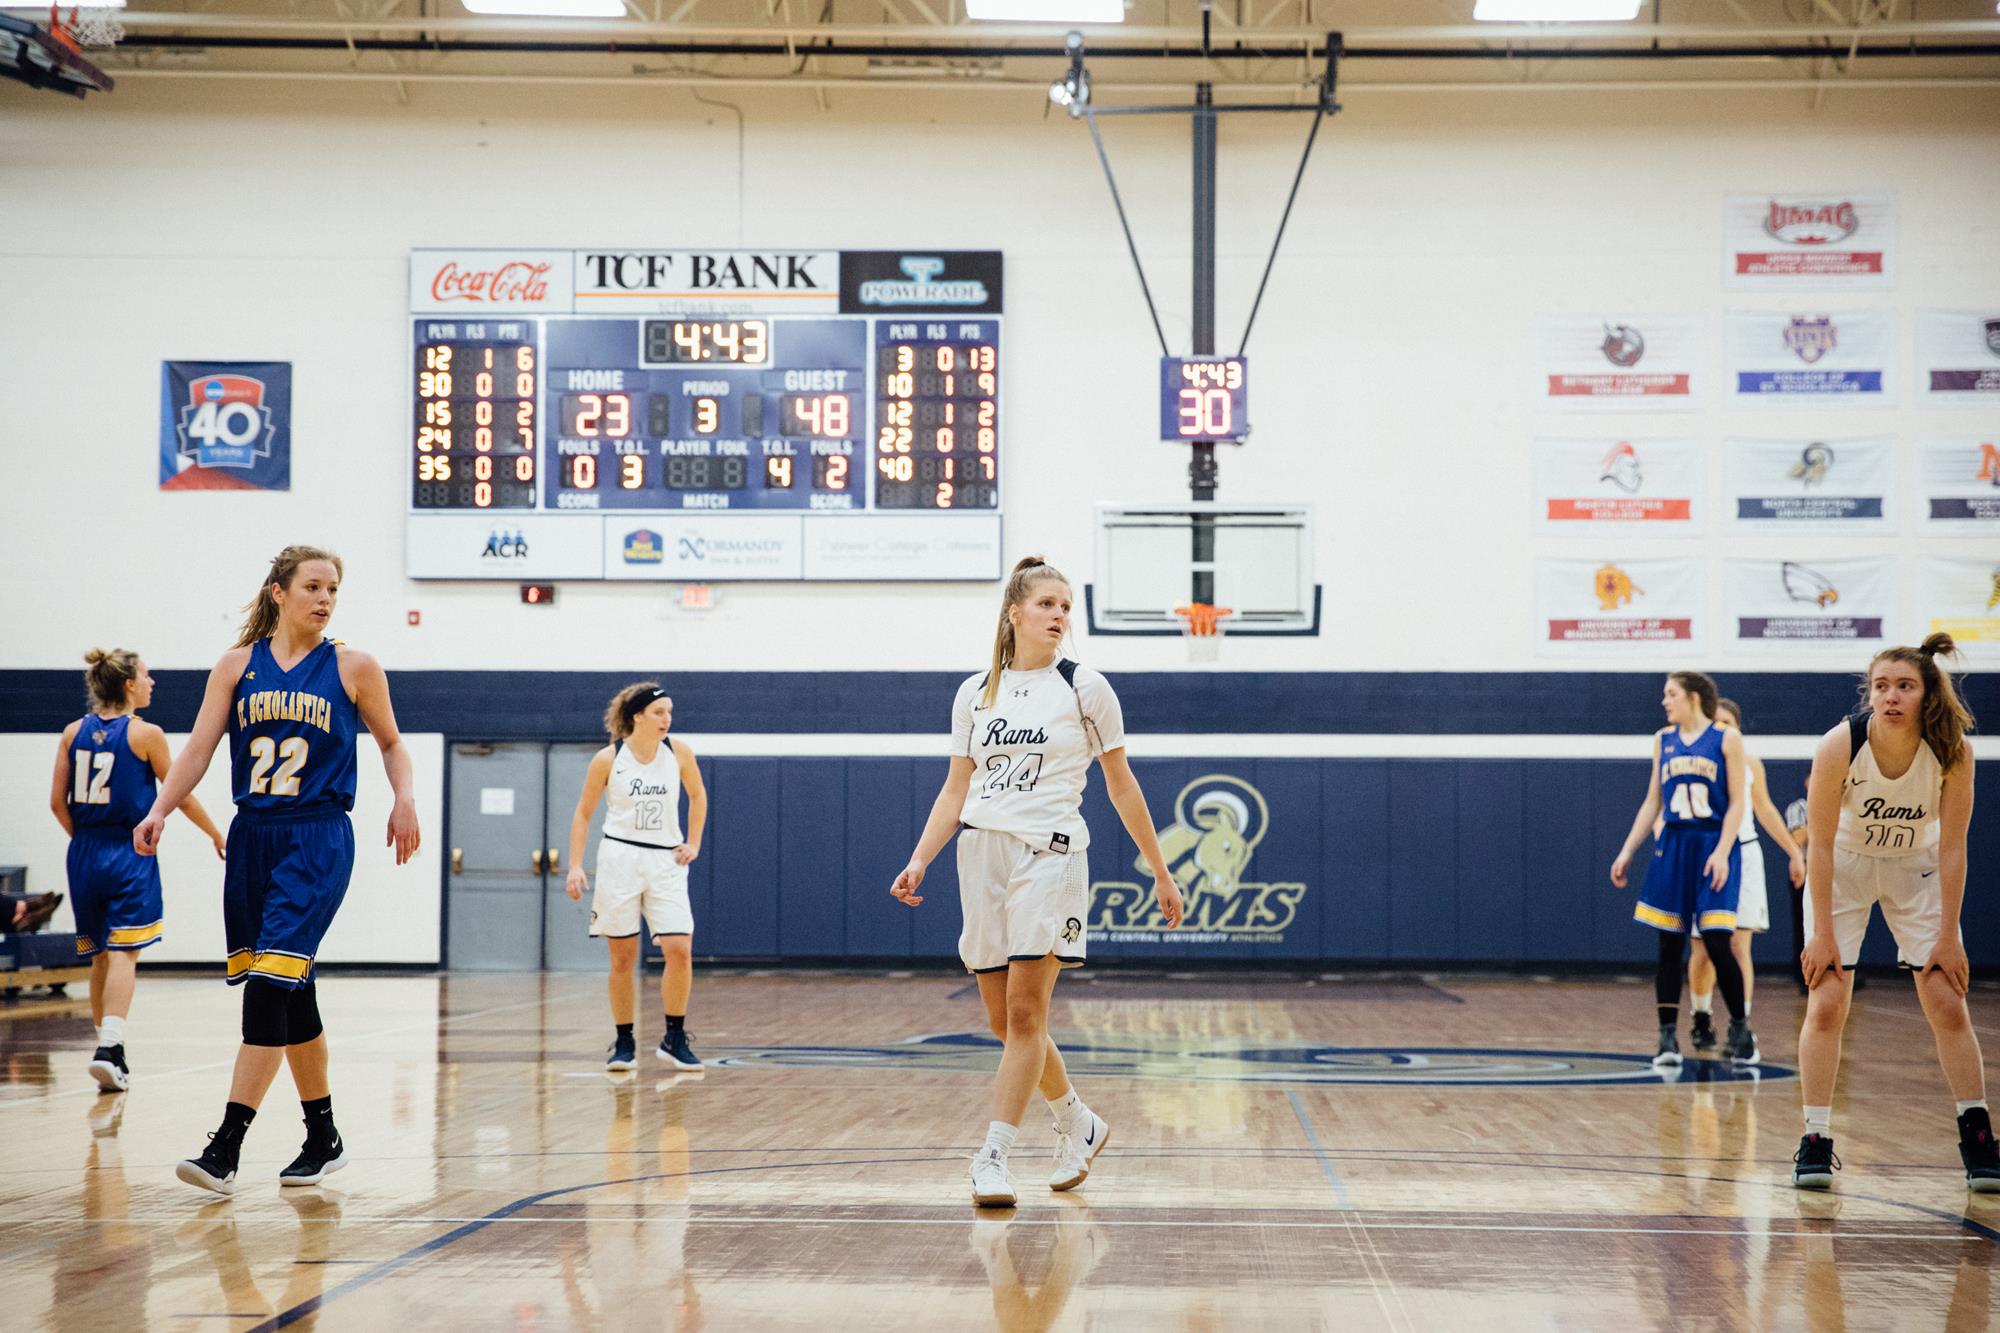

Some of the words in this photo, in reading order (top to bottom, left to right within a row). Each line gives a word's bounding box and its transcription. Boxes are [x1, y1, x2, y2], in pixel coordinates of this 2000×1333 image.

[1769, 200, 1853, 232] UMAC
[586, 255, 672, 288] TCF
[691, 255, 818, 288] BANK
[862, 282, 986, 302] POWERADE
[675, 320, 766, 363] 4:43
[426, 346, 452, 371] 12
[484, 348, 493, 369] 1
[517, 346, 534, 371] 6
[898, 346, 913, 371] 3
[937, 346, 954, 371] 0
[970, 346, 995, 371] 13
[419, 372, 452, 397] 30
[476, 373, 493, 397] 0
[517, 373, 534, 397] 0
[568, 370, 624, 391] HOME
[784, 370, 848, 391] GUEST
[887, 372, 913, 397] 10
[945, 374, 954, 396] 1
[978, 373, 995, 396] 9
[1182, 361, 1242, 389] 4:43
[682, 381, 730, 396] PERIOD
[188, 401, 260, 446] 40
[426, 401, 452, 426] 15
[475, 401, 492, 426] 0
[517, 401, 533, 426] 2
[575, 394, 629, 437] 23
[698, 399, 717, 433] 3
[795, 394, 848, 437] 48
[887, 401, 913, 426] 12
[945, 403, 954, 425] 1
[977, 401, 995, 426] 2
[1179, 389, 1231, 435] 30
[417, 427, 452, 452] 24
[475, 427, 492, 452] 0
[518, 428, 533, 451] 7
[558, 440, 600, 456] FOULS
[661, 440, 710, 456] PLAYER
[716, 440, 750, 456] FOUL
[810, 440, 853, 456] FOULS
[879, 427, 913, 453] 22
[936, 427, 953, 453] 0
[977, 427, 995, 453] 8
[419, 455, 452, 480] 35
[475, 455, 492, 481] 0
[516, 455, 533, 481] 0
[573, 454, 595, 489] 0
[622, 455, 643, 490] 3
[769, 456, 791, 487] 4
[826, 455, 848, 489] 2
[879, 455, 913, 481] 40
[945, 458, 954, 480] 1
[979, 456, 995, 480] 7
[475, 482, 492, 507] 0
[558, 494, 600, 509] SCORE
[683, 494, 729, 509] MATCH
[936, 482, 953, 508] 2
[482, 544, 528, 558] ACR
[249, 690, 331, 734] SCHOLASTICA
[982, 718, 1048, 746] Rams
[75, 749, 115, 804] 12
[249, 736, 309, 796] 22
[981, 753, 1043, 799] 24
[629, 778, 668, 796] Rams
[635, 800, 663, 830] 12
[1859, 797, 1926, 820] Rams
[1058, 835, 1065, 843] M
[1088, 881, 1307, 932] RAMS
